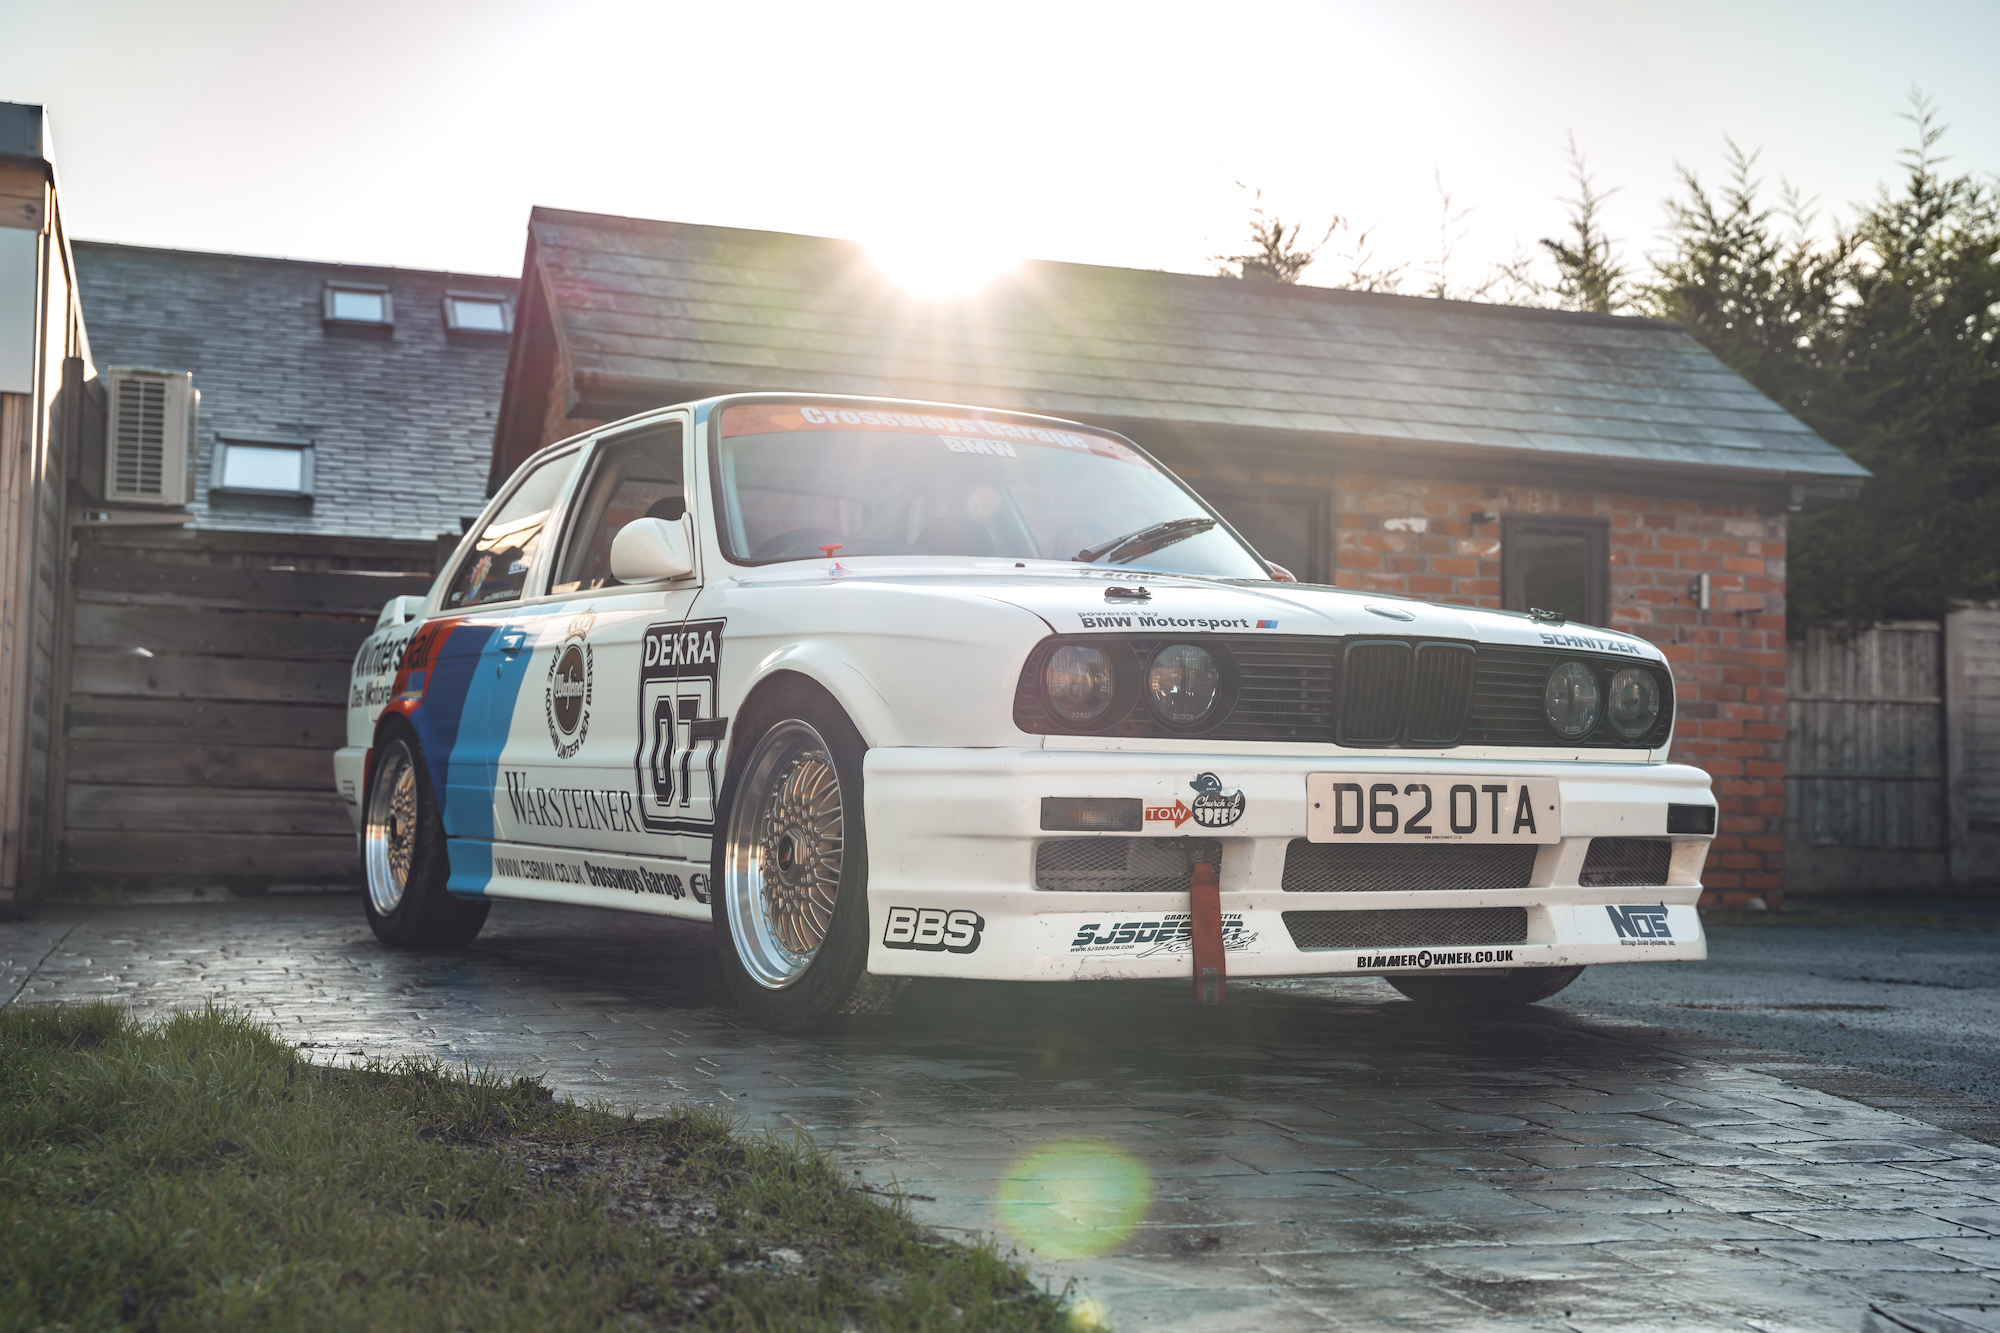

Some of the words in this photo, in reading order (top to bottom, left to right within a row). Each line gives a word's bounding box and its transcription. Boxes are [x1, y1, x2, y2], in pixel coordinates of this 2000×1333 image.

[800, 406, 979, 433] Crossways
[980, 419, 1091, 450] Garage
[941, 437, 1018, 458] BMW
[1081, 617, 1132, 628] BMW
[1138, 616, 1249, 630] Motorsport
[356, 623, 442, 678] Wintershall
[644, 631, 716, 667] DEKRA
[1539, 633, 1641, 655] SCHNITZER
[546, 645, 561, 683] EINE
[557, 738, 579, 760] UNTER
[579, 710, 590, 745] DEN
[650, 694, 701, 808] 07
[504, 771, 641, 833] WARSTEINER
[1147, 808, 1187, 820] TOW
[1194, 794, 1226, 807] Church
[1227, 793, 1241, 807] of
[1194, 807, 1241, 825] SPEED
[1332, 782, 1432, 834] D62
[1449, 784, 1537, 834] OTA
[494, 857, 586, 885] WWW.C3BMW.CO.UK
[584, 860, 645, 894] Crossways
[640, 866, 686, 900] Garage
[882, 906, 985, 954] BBS
[1604, 905, 1673, 938] NOS
[1070, 944, 1135, 953] WWW.SJSDESIGN.COM
